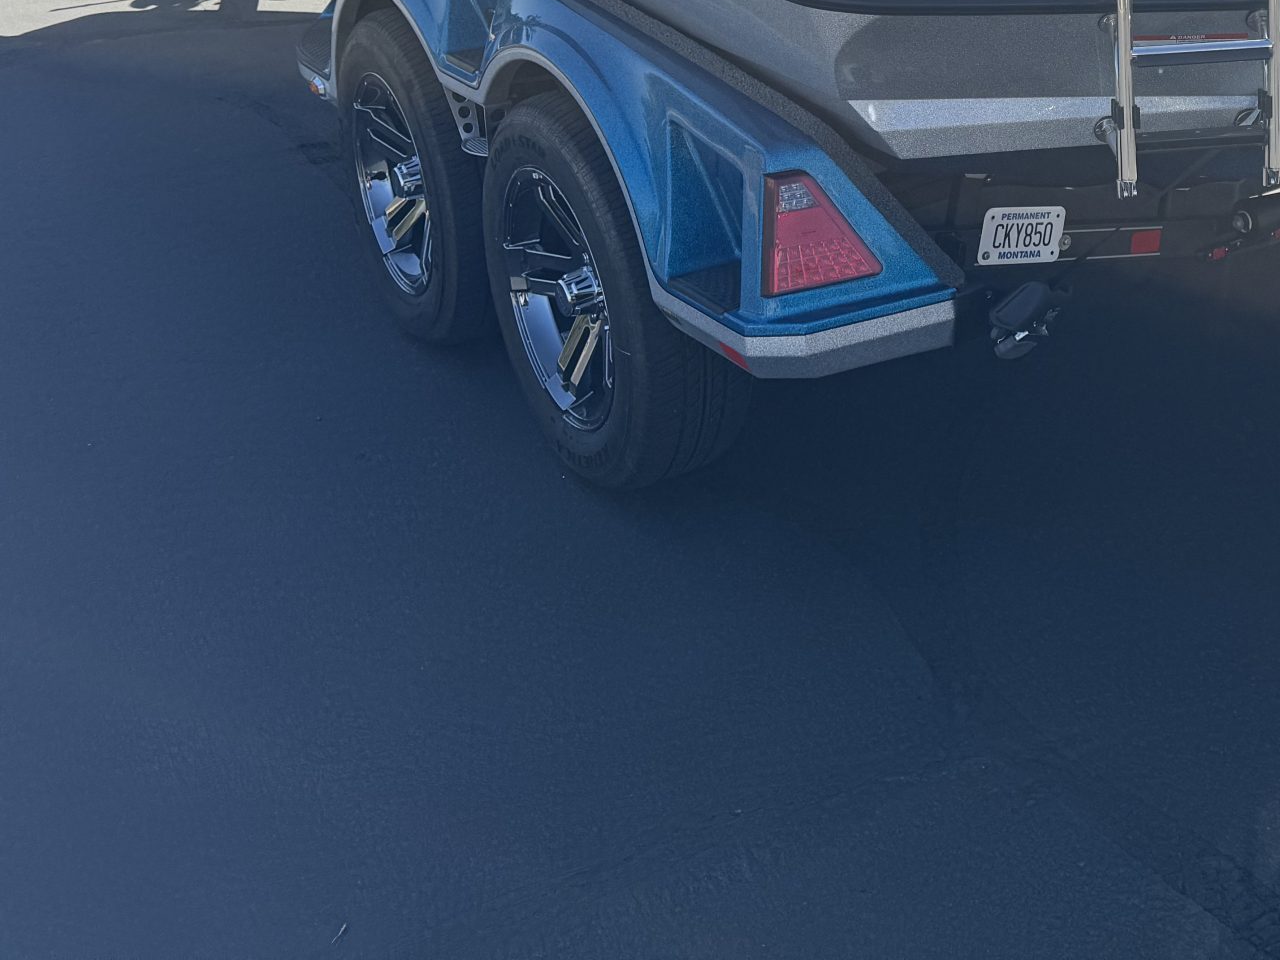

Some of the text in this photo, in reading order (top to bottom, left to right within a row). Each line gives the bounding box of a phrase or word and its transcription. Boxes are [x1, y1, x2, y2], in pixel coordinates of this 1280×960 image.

[1001, 212, 1051, 220] PERMANENT
[993, 222, 1053, 248] CKY850
[998, 250, 1041, 259] MONTANA
